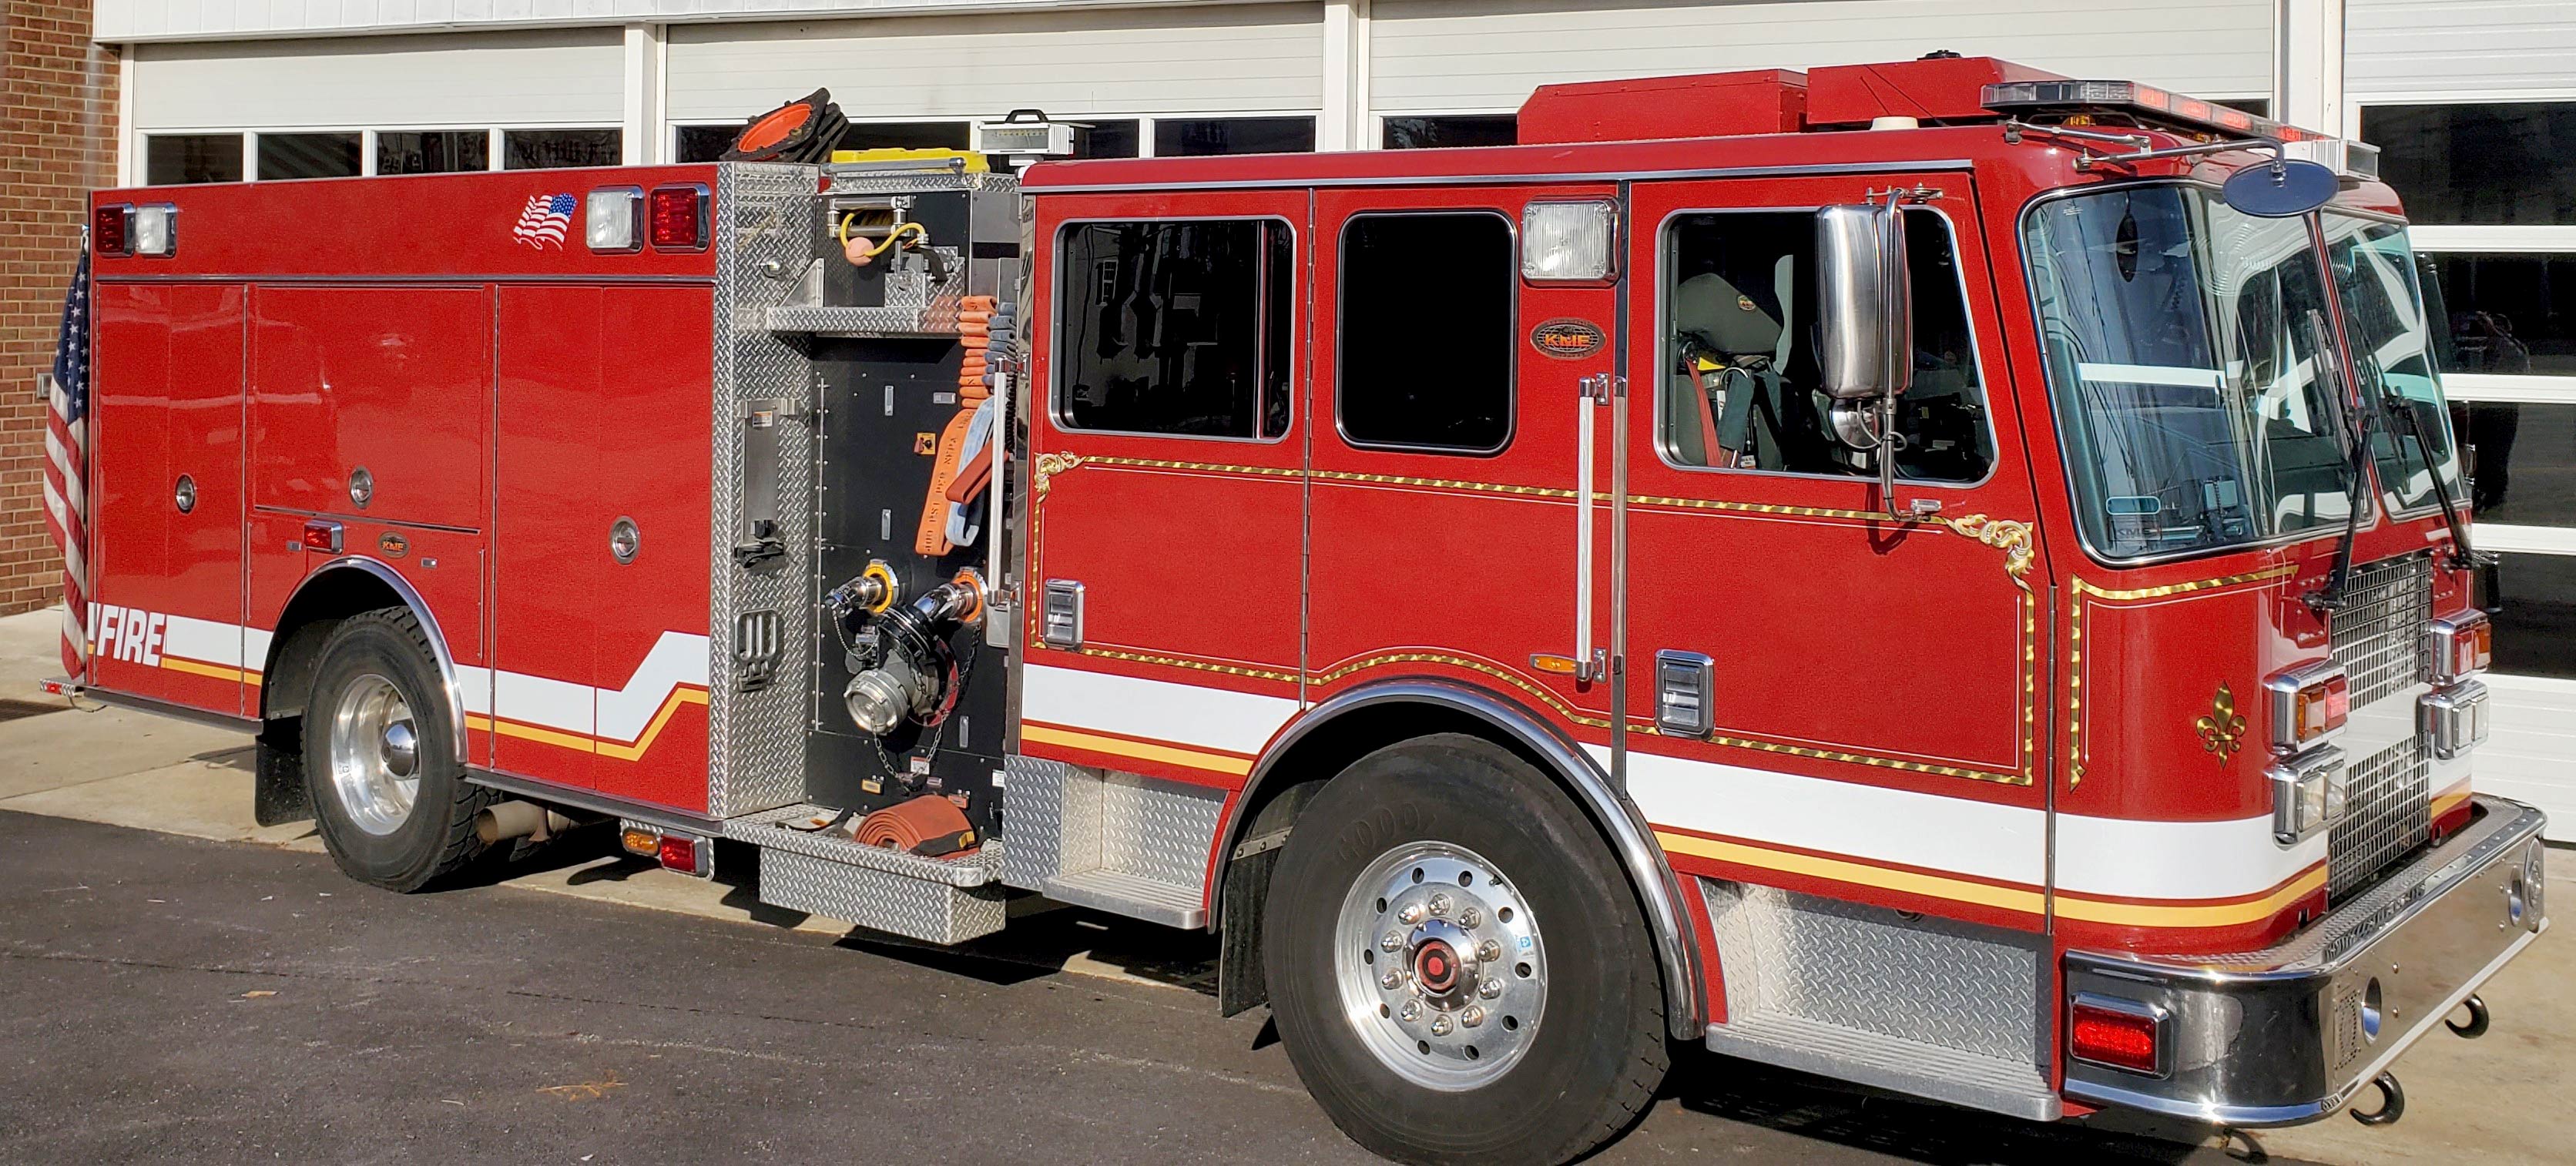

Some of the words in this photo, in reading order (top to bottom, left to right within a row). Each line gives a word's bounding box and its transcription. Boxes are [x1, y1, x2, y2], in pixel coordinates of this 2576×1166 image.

[1545, 333, 1590, 347] KME
[383, 541, 404, 551] KME
[97, 604, 166, 667] FIRE
